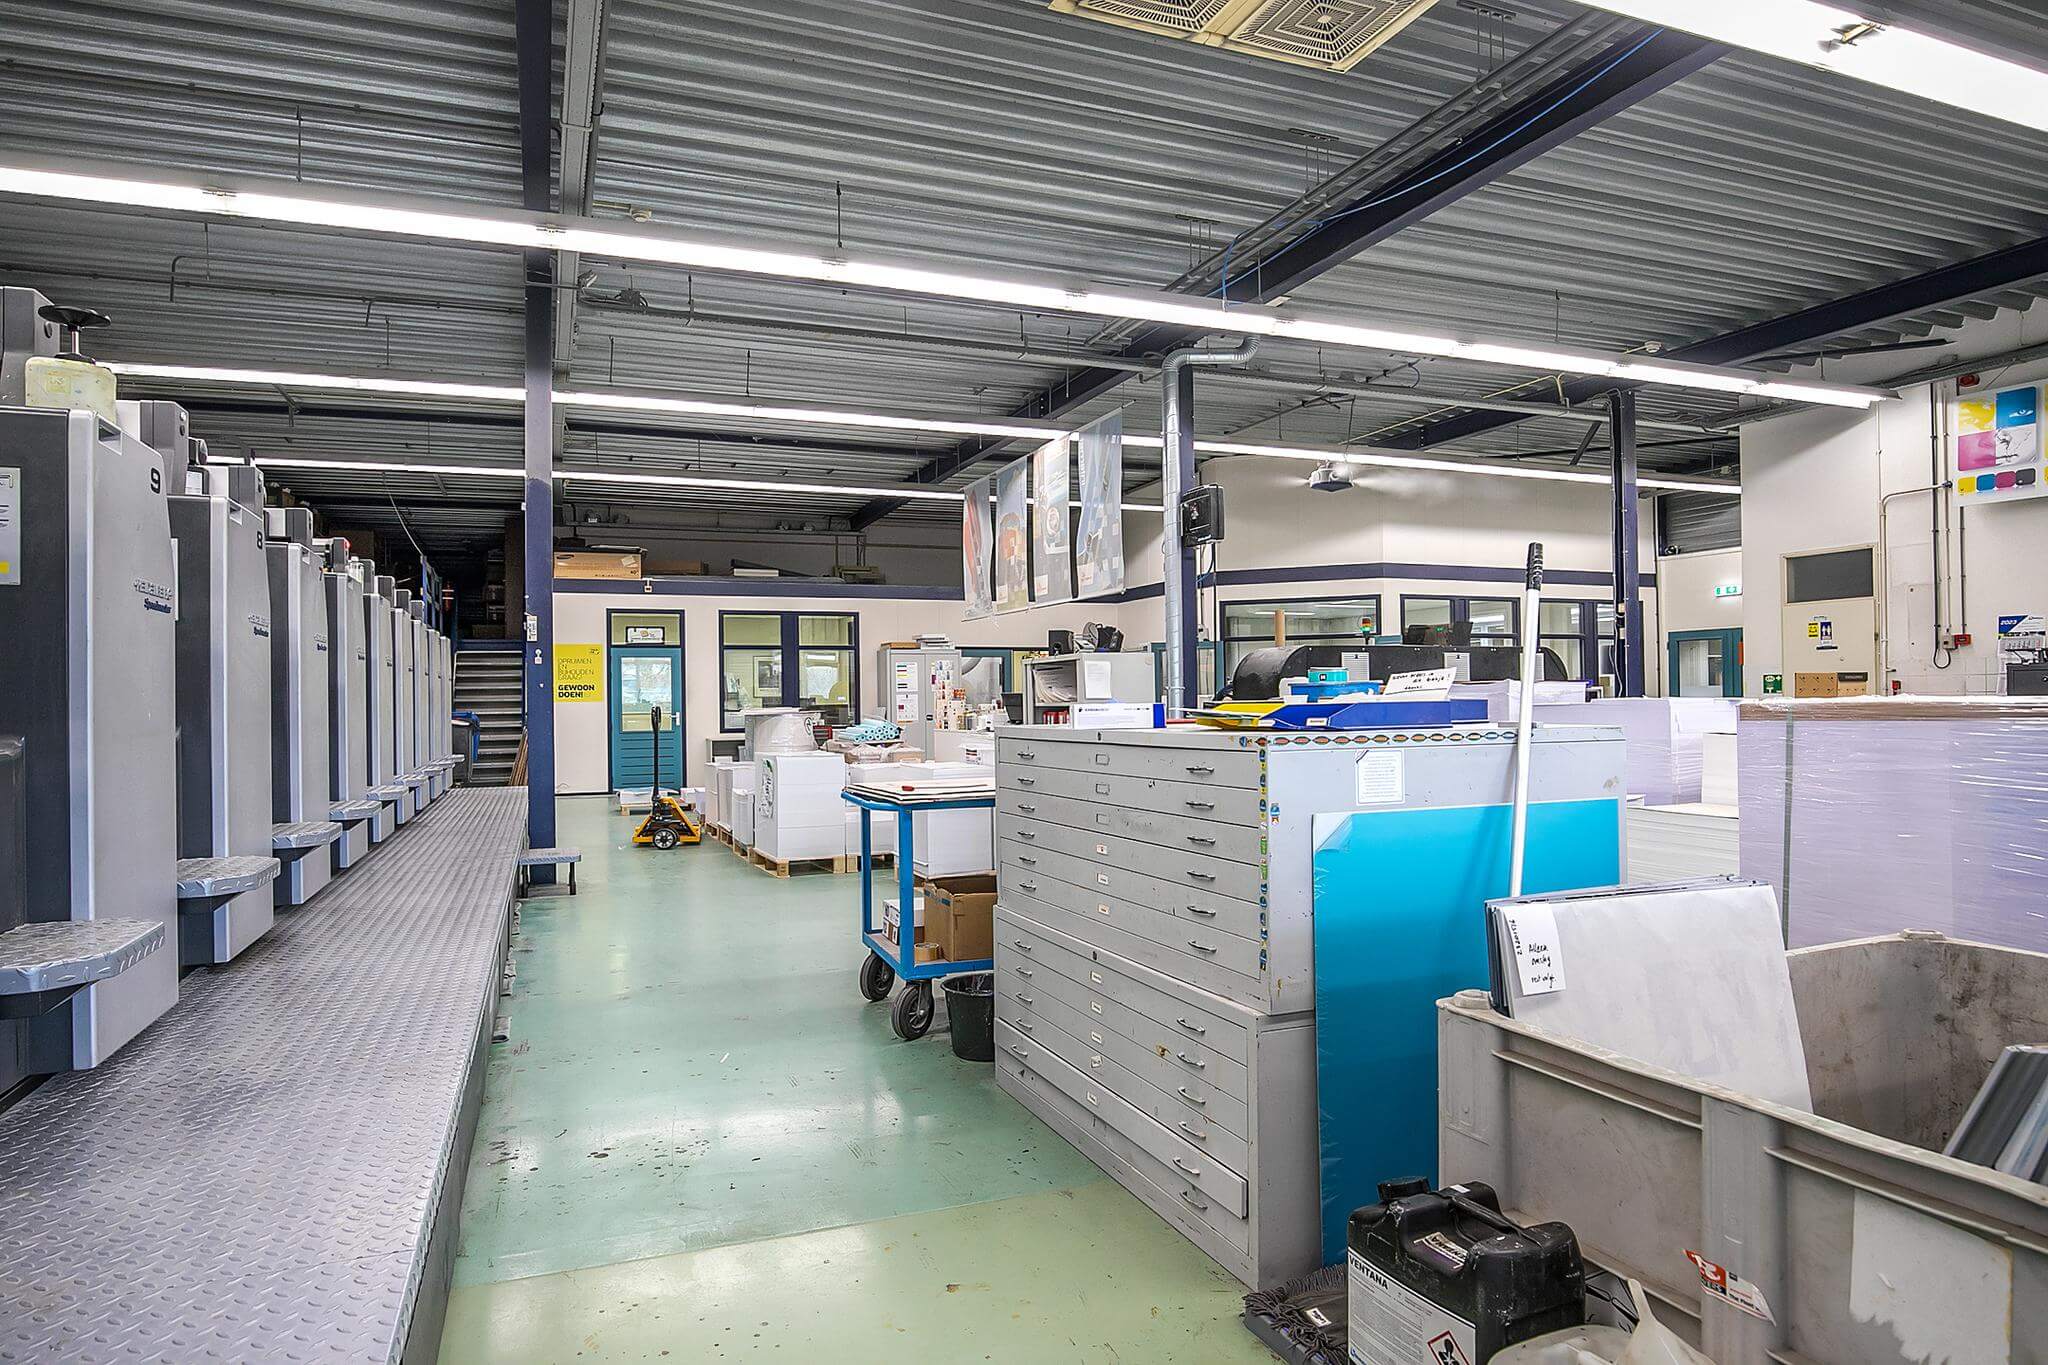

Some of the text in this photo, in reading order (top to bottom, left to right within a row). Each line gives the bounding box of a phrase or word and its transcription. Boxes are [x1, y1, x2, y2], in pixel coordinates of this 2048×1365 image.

[150, 467, 161, 494] 9
[256, 531, 263, 550] 8
[1348, 1254, 1389, 1290] VENTANA
